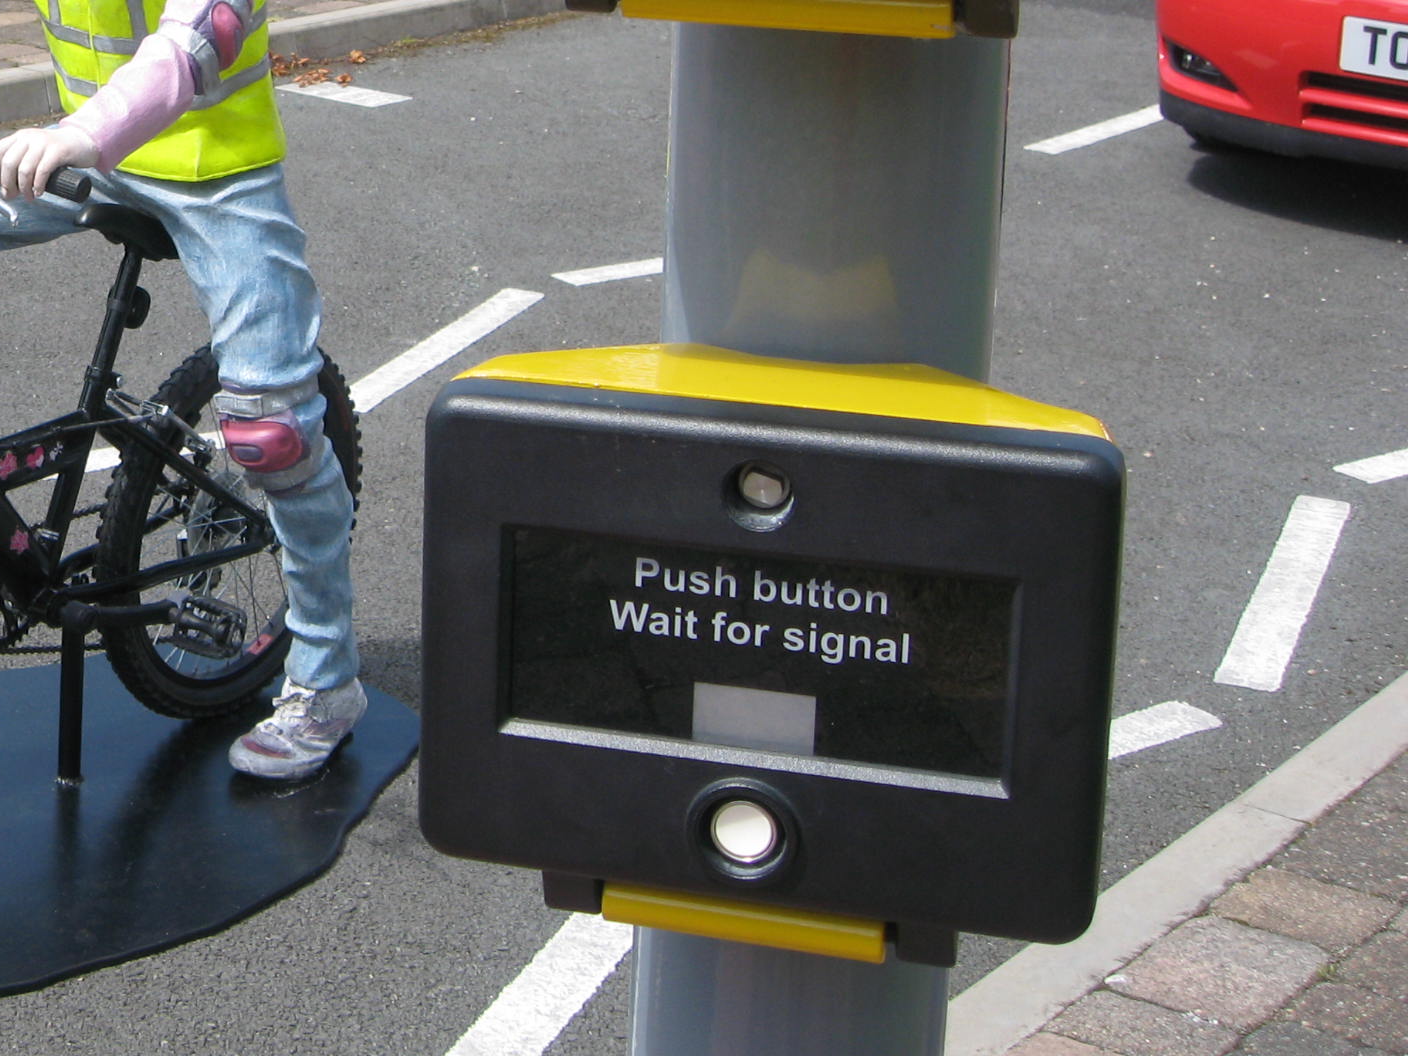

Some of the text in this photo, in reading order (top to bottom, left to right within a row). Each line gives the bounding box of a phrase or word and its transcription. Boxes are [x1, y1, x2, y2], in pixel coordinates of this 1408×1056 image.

[635, 557, 888, 615] Push button
[609, 599, 910, 664] Wait for signal
